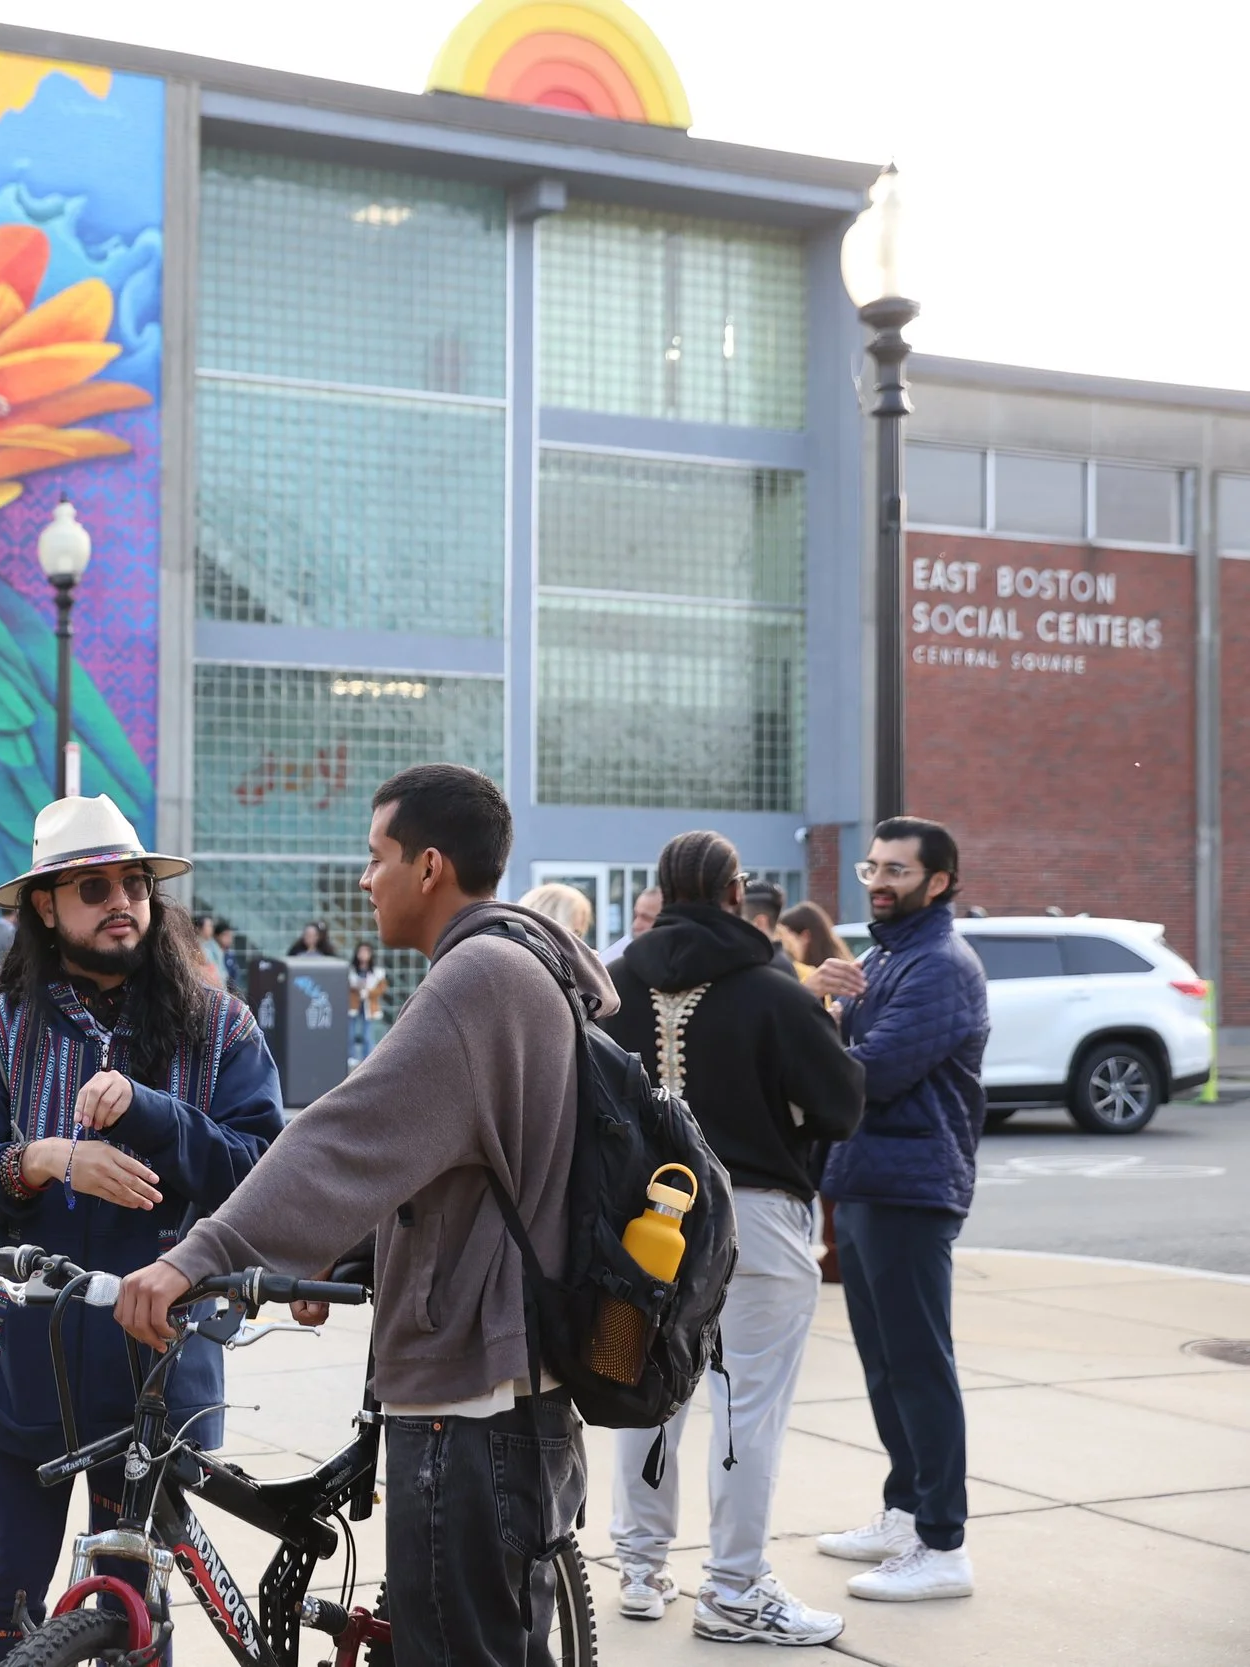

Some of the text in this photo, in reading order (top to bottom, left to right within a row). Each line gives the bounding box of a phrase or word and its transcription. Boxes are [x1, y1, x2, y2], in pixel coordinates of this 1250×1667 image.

[912, 558, 1116, 604] EAST BOSTON
[911, 602, 1163, 650] SOCIAL CENTERS
[912, 645, 1086, 674] CENTRAL SQUARE
[61, 1455, 92, 1473] Master
[186, 1511, 261, 1660] MONGOOSE
